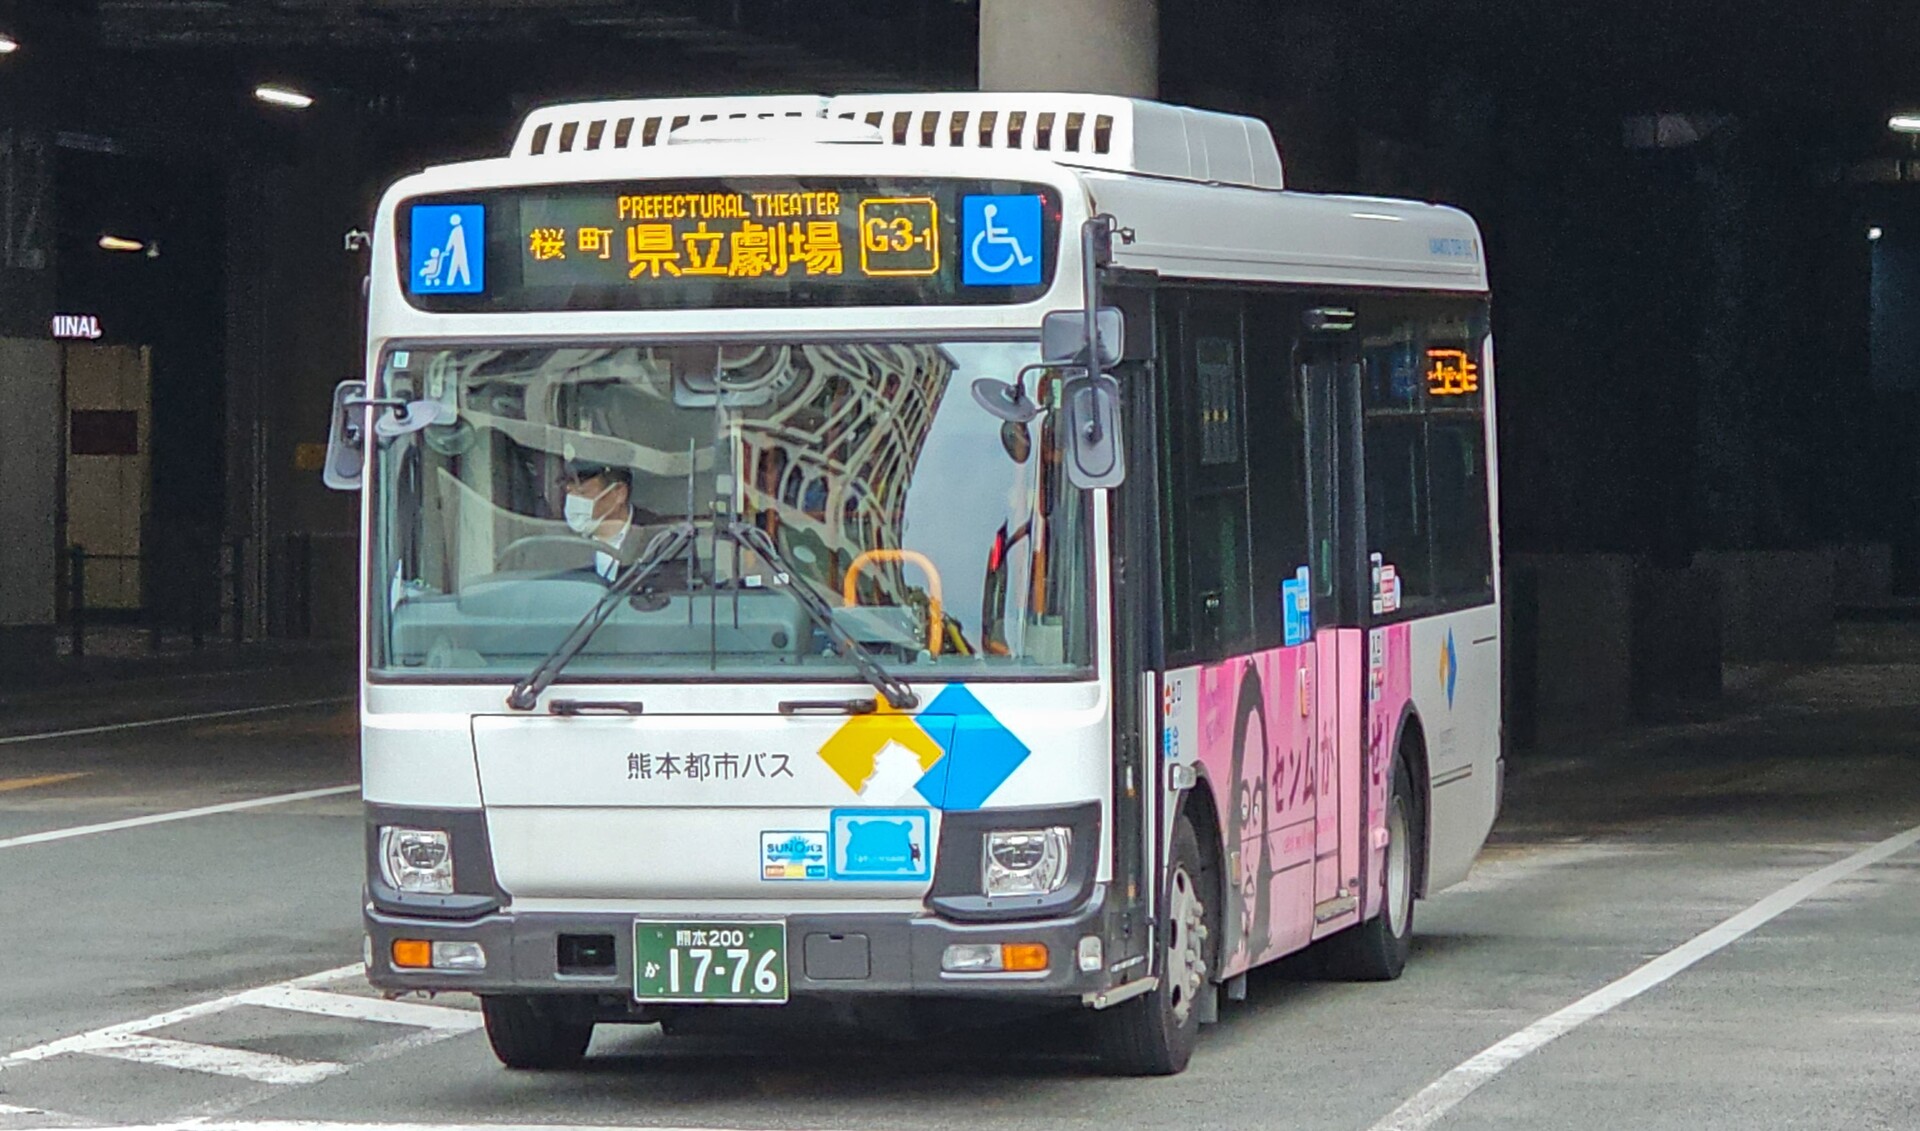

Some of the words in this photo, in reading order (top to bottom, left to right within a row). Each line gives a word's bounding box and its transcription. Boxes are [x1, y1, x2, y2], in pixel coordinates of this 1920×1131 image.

[618, 193, 750, 220] PREFECTURAL
[752, 192, 840, 217] THEATER
[529, 227, 614, 260] 桜町
[627, 220, 843, 279] 県立劇場
[865, 217, 932, 252] G3-1
[627, 751, 794, 782] 熊本都市バス
[644, 961, 661, 978] か
[669, 948, 777, 993] 17-76
